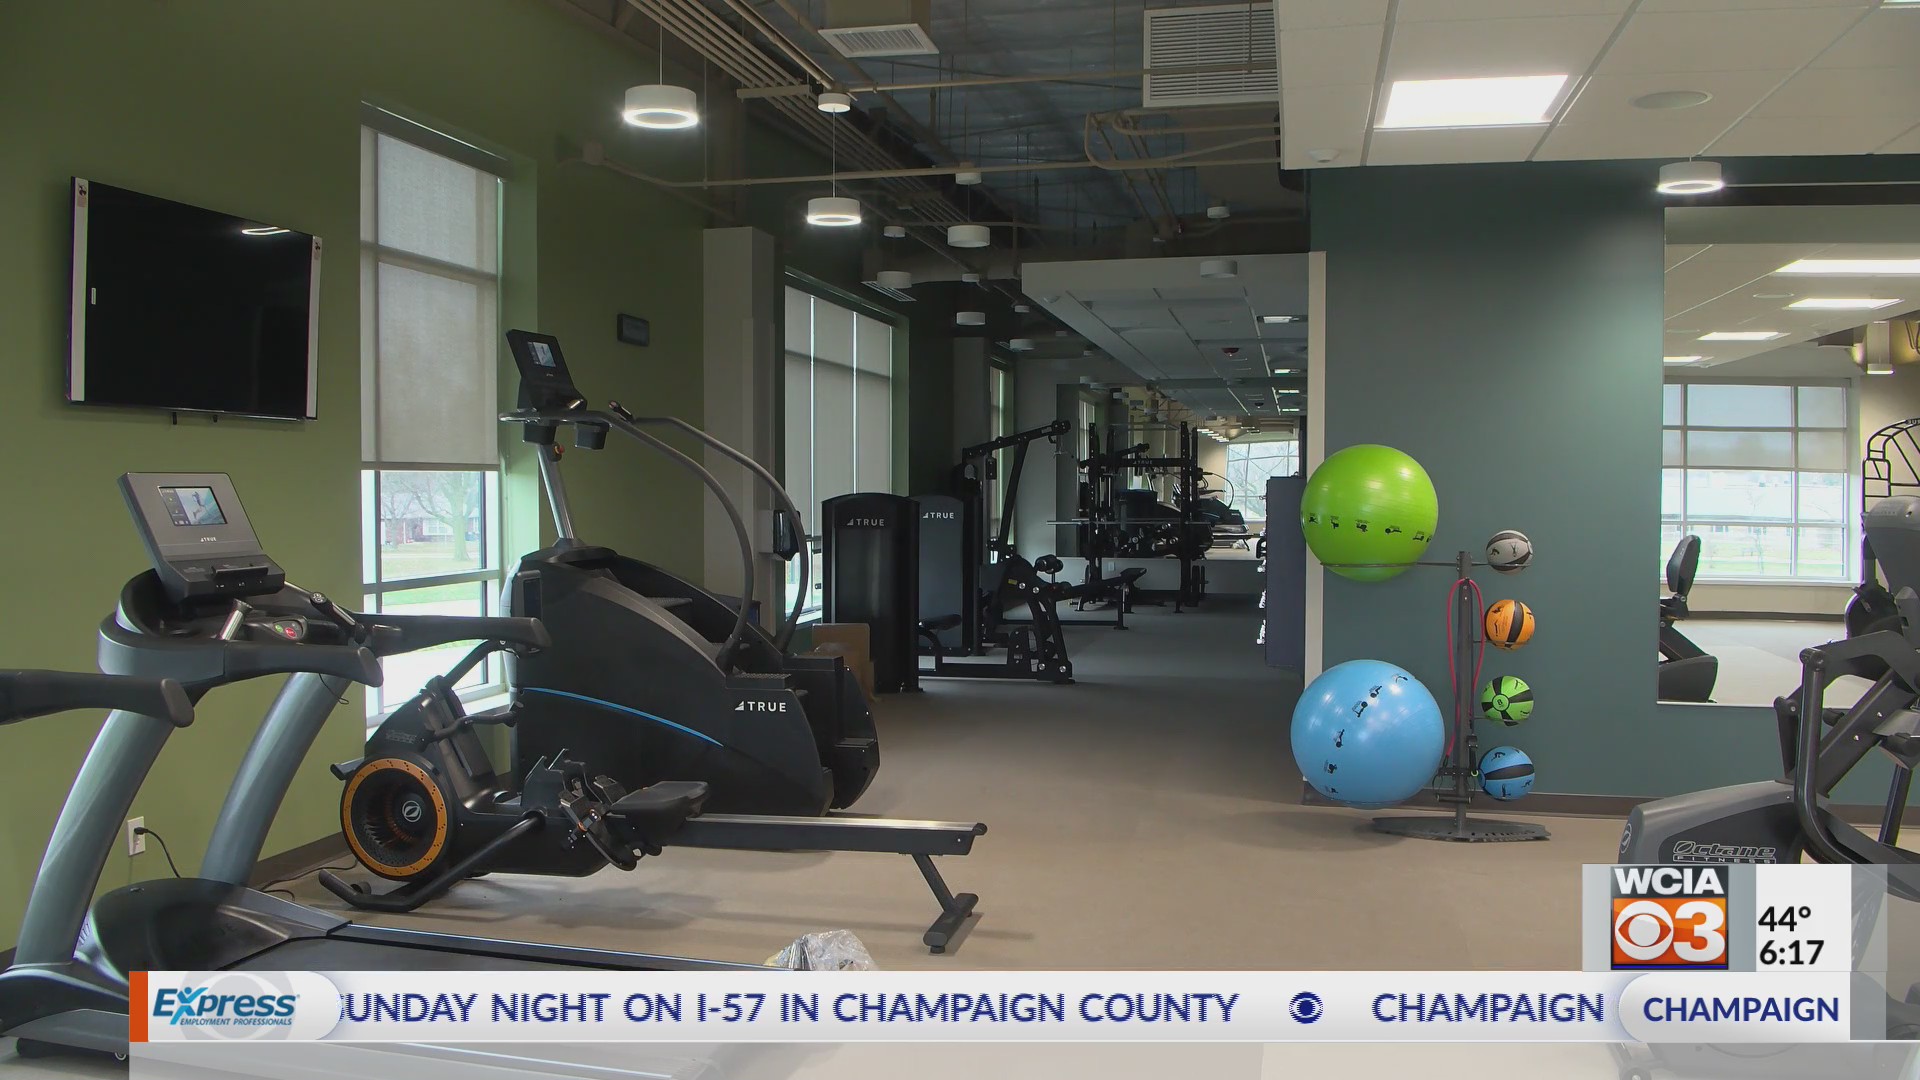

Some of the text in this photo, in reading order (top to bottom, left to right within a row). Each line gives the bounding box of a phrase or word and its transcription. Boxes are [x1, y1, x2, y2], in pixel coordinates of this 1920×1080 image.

[856, 518, 885, 526] TRUE
[747, 701, 787, 712] TRUE
[1673, 840, 1776, 858] Octane
[1677, 856, 1771, 864] FITNESS
